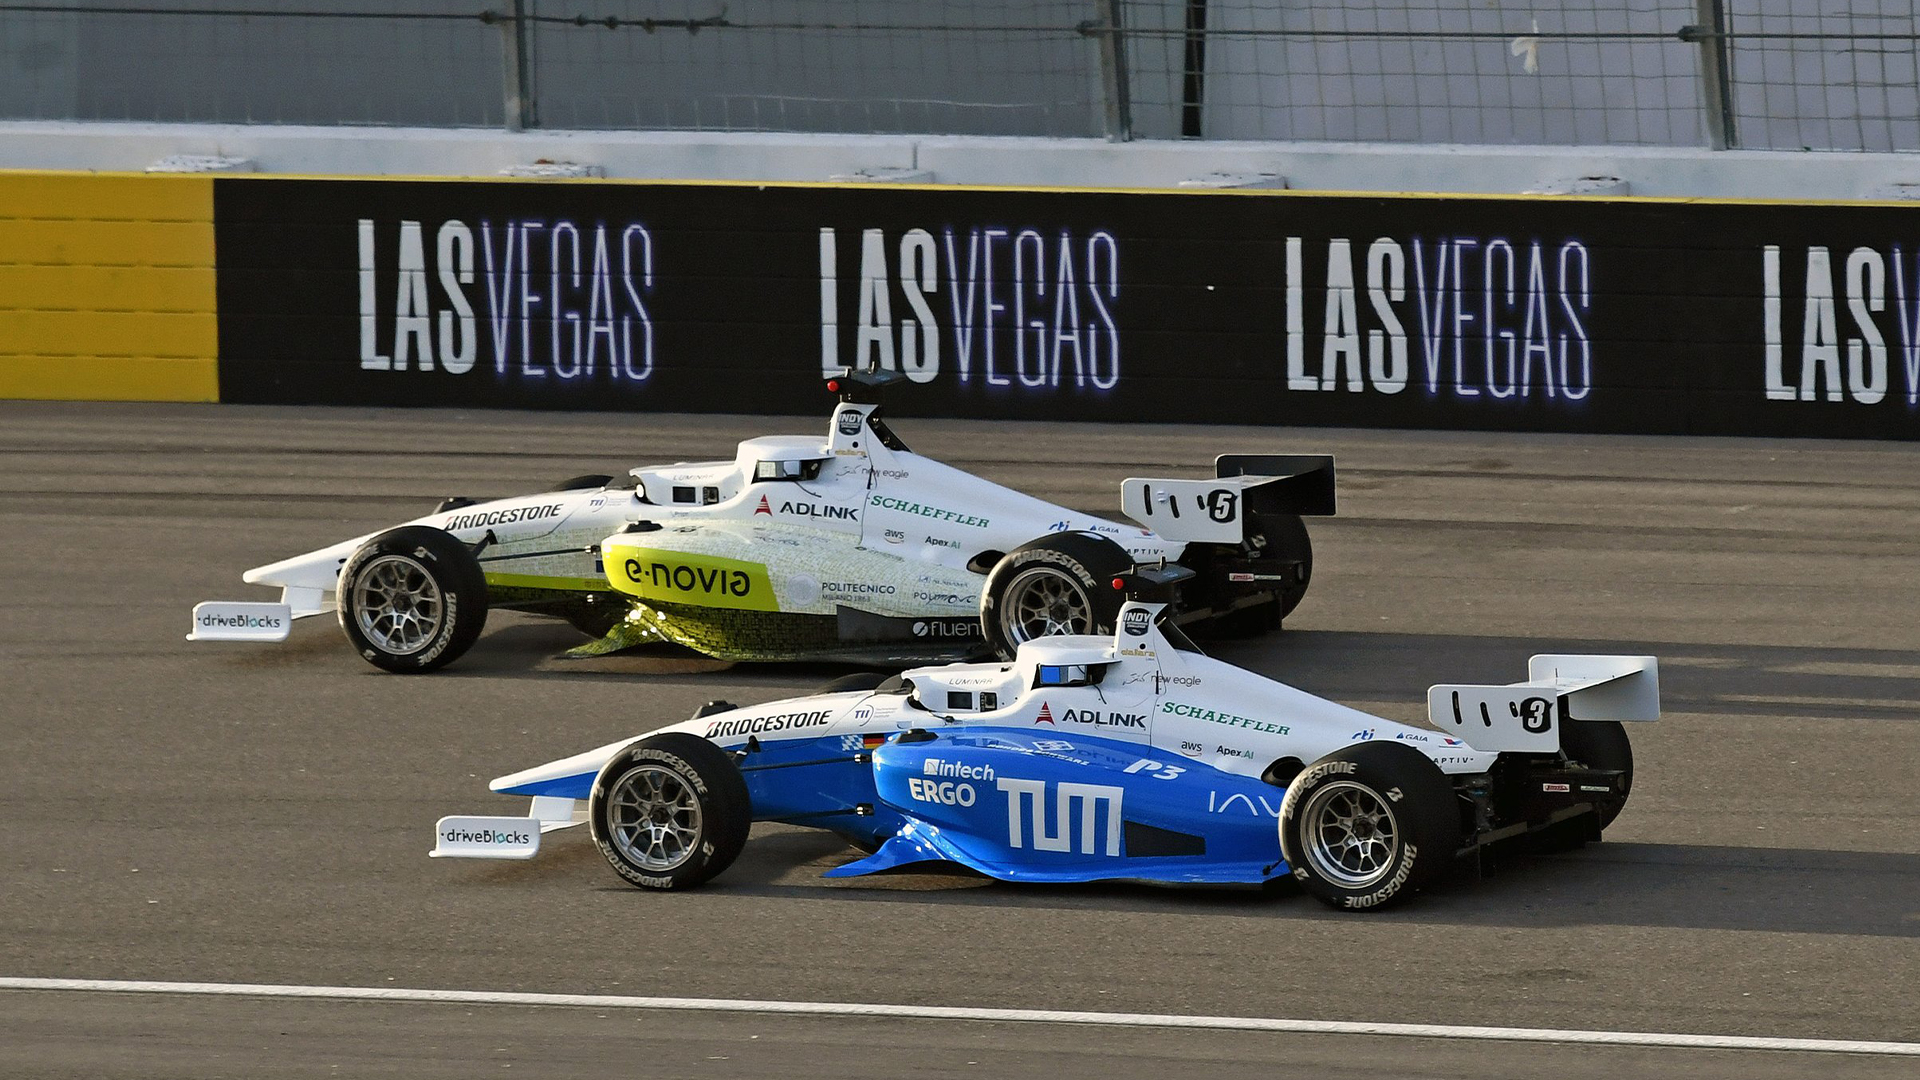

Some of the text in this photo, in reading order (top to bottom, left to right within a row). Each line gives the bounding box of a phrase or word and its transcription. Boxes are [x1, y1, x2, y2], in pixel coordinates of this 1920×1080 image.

[838, 413, 865, 423] INDY
[882, 469, 909, 480] eagle
[780, 501, 859, 522] ADLINK
[870, 495, 990, 528] SCHAEFFLER
[1213, 493, 1233, 519] 5
[444, 503, 564, 532] BRIDGESTONE
[884, 529, 905, 540] aws
[924, 535, 961, 550] Apex.AI
[1012, 548, 1098, 589] BRIDGESTONE
[821, 582, 896, 595] POLITECNICO
[1124, 612, 1153, 623] INDY
[930, 621, 983, 637] fluen
[1173, 675, 1201, 688] eagle
[704, 710, 833, 739] BRIDGESTONE
[1062, 708, 1147, 731] ADLINK
[1162, 702, 1291, 736] SCHAEFFLER
[1527, 700, 1545, 729] 3
[1181, 740, 1202, 752] aws
[1405, 733, 1429, 743] GAIA
[1216, 745, 1254, 760] Apex.AI
[631, 748, 708, 794] BRIDGESTONE
[939, 760, 994, 781] intech
[1123, 758, 1187, 780] P3
[908, 778, 976, 807] ERGO
[1284, 761, 1358, 821] BRIDGESTONE
[997, 777, 1124, 857] TUM
[600, 840, 674, 888] BRIDGESTONE
[1344, 841, 1418, 909] BRIDGESTONE
